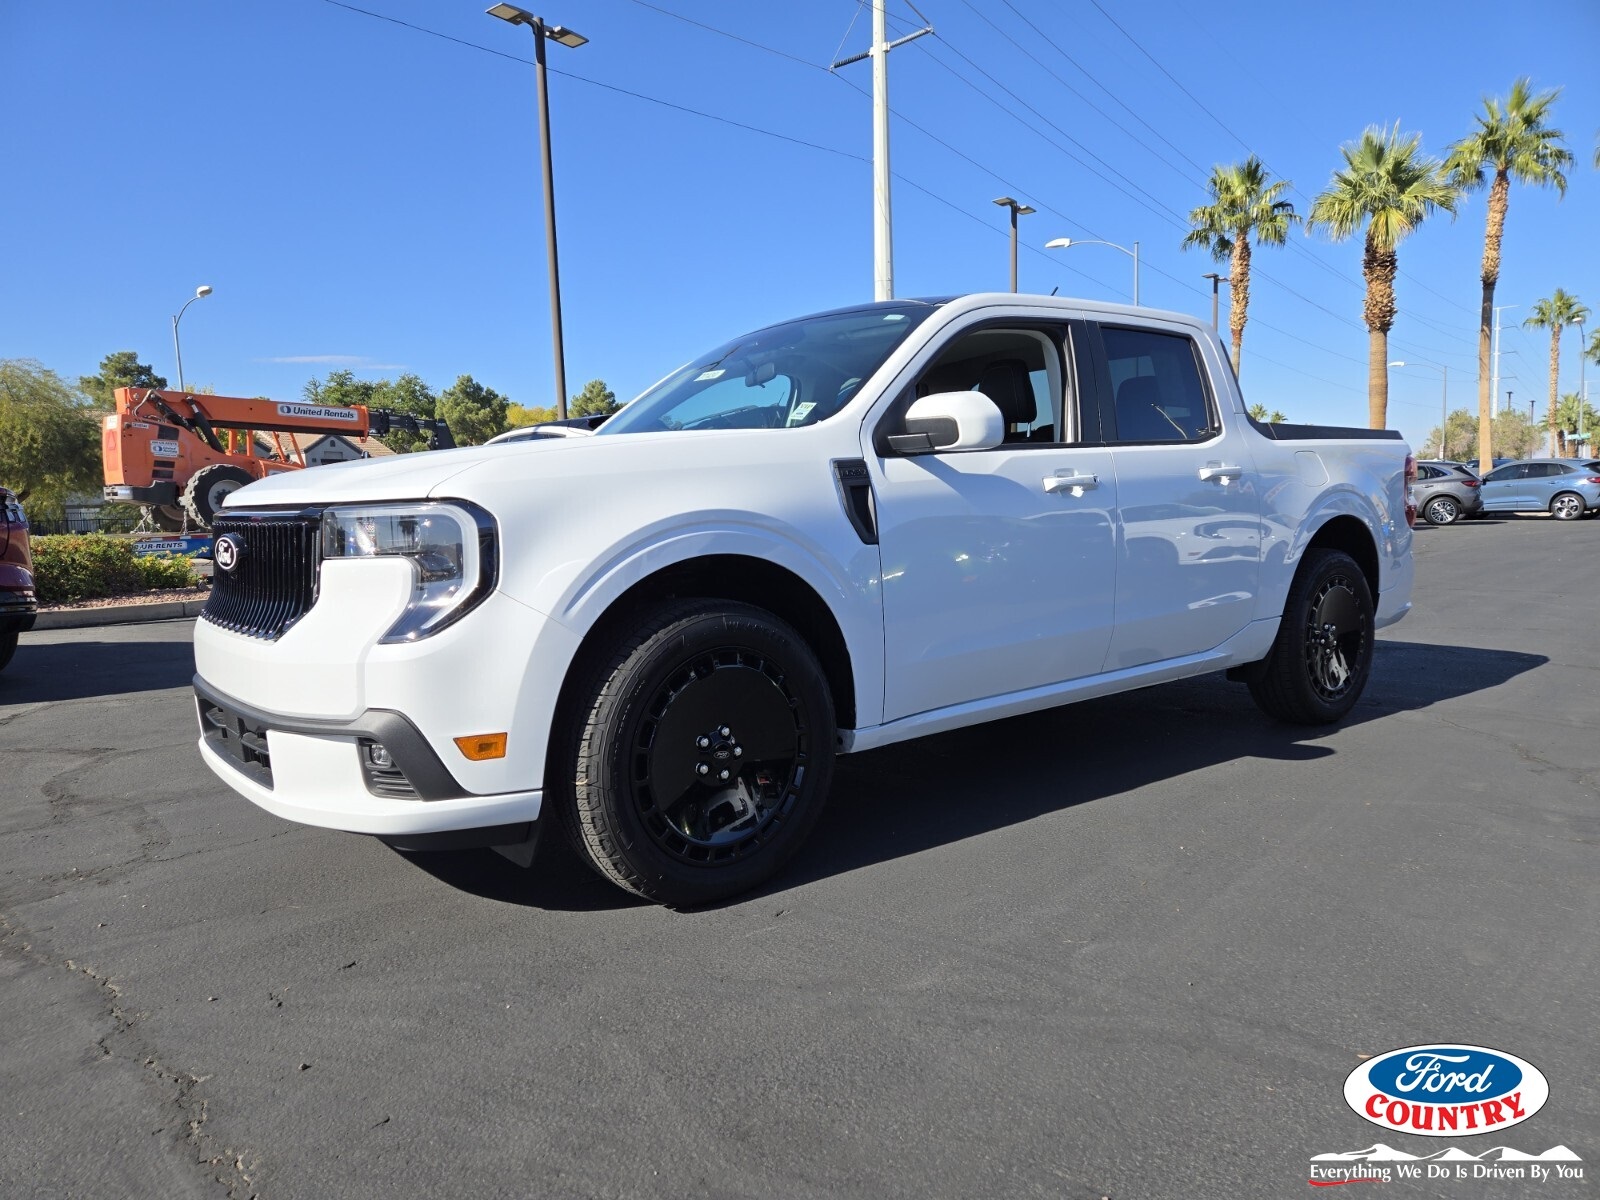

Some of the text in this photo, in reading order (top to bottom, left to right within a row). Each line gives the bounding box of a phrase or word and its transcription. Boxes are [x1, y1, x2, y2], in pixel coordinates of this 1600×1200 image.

[293, 406, 354, 419] United Rentals
[218, 541, 231, 564] Ford
